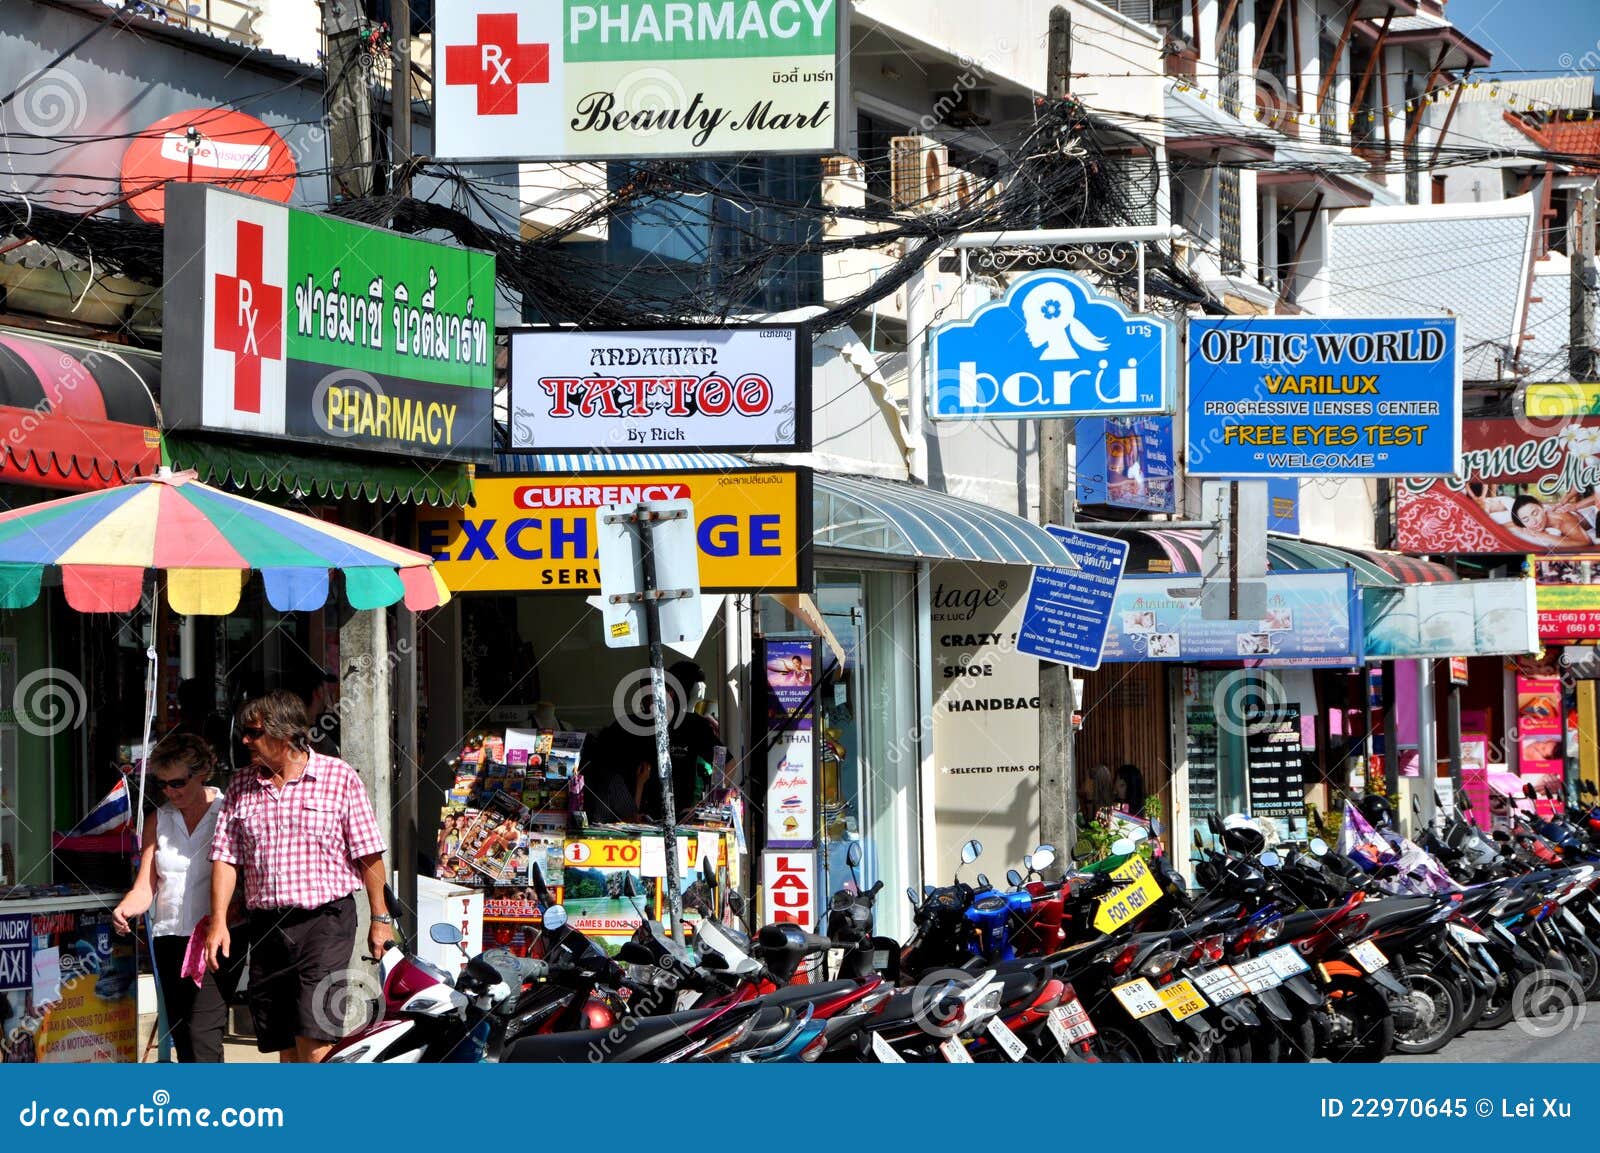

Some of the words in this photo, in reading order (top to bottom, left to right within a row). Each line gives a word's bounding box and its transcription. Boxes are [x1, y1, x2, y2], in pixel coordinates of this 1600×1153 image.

[569, 0, 833, 44] PHARMACY
[570, 91, 731, 147] Beauty
[730, 100, 832, 132] Mart
[295, 267, 384, 350] ฟาร์มาซี
[590, 346, 719, 366] ANDAMAN
[1201, 329, 1307, 364] OPTIC
[1313, 328, 1445, 364] WORLD
[538, 372, 774, 418] TATTOO
[1264, 375, 1379, 395] VARILUX
[327, 385, 457, 447] PHARMACY
[1204, 401, 1308, 416] PROGRESSIVE
[1314, 401, 1372, 416] LENSES
[1377, 401, 1439, 416] CENTER
[626, 427, 647, 444] By
[651, 427, 686, 442] Nick
[1223, 425, 1287, 446] FREE
[1292, 425, 1359, 446] EYES
[1364, 424, 1428, 446] TEST
[1537, 450, 1600, 496] Ma
[523, 485, 681, 508] CURRENCY
[417, 514, 783, 562] EXCHGE
[940, 632, 1003, 647] CRAZY
[943, 664, 994, 679] SHOE
[950, 766, 994, 775] SELECTED
[997, 765, 1025, 773] ITEMS
[484, 907, 543, 917] ANTASEA
[1107, 901, 1130, 925] FOR
[1126, 886, 1149, 911] RENT
[575, 919, 603, 928] JAMES
[1136, 1000, 1157, 1014] 216
